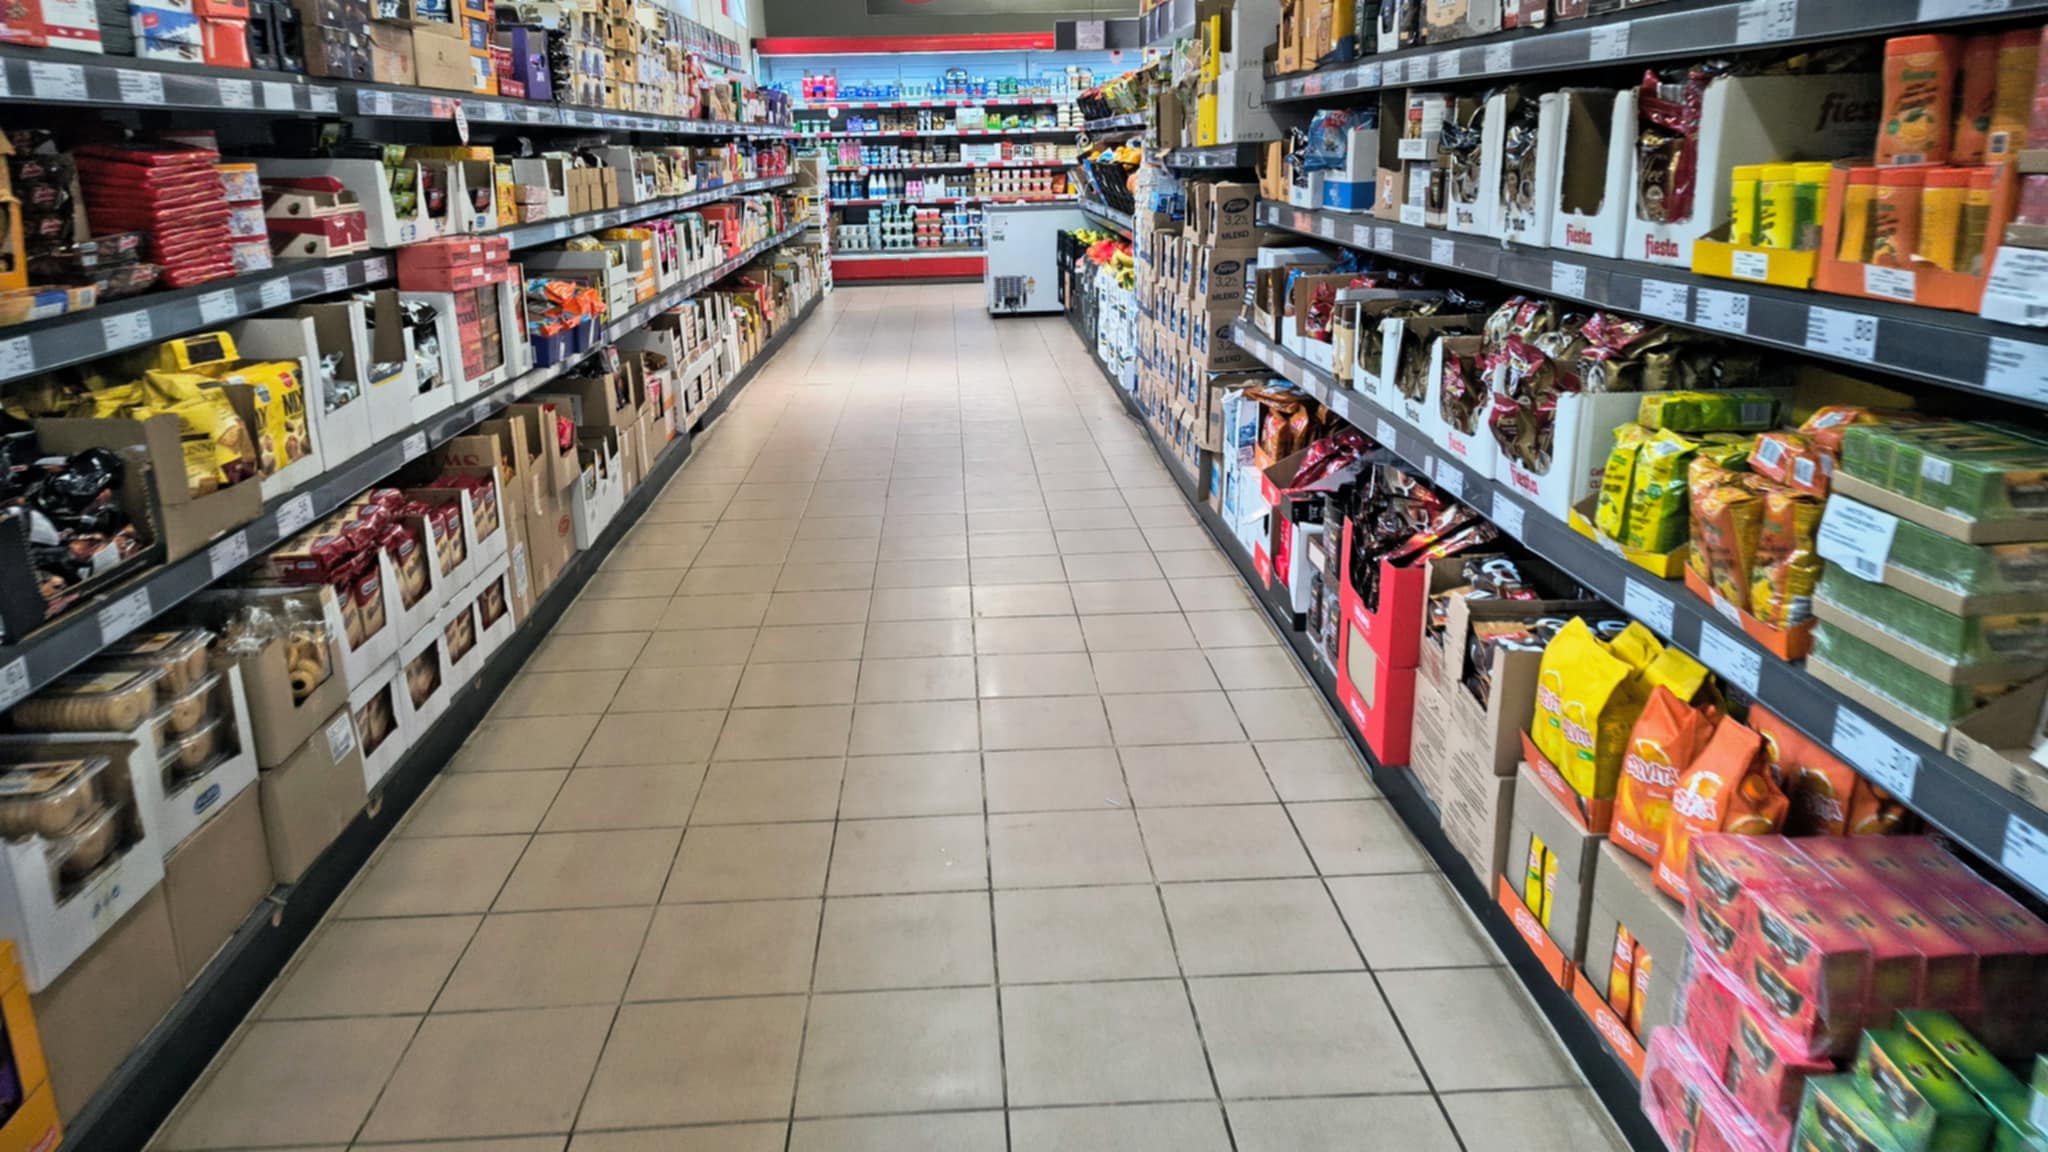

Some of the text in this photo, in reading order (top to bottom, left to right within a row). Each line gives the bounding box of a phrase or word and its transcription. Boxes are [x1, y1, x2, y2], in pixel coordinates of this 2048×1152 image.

[1221, 230, 1250, 241] MLEKO
[1565, 223, 1593, 246] fiesta
[1644, 233, 1679, 259] fiesta
